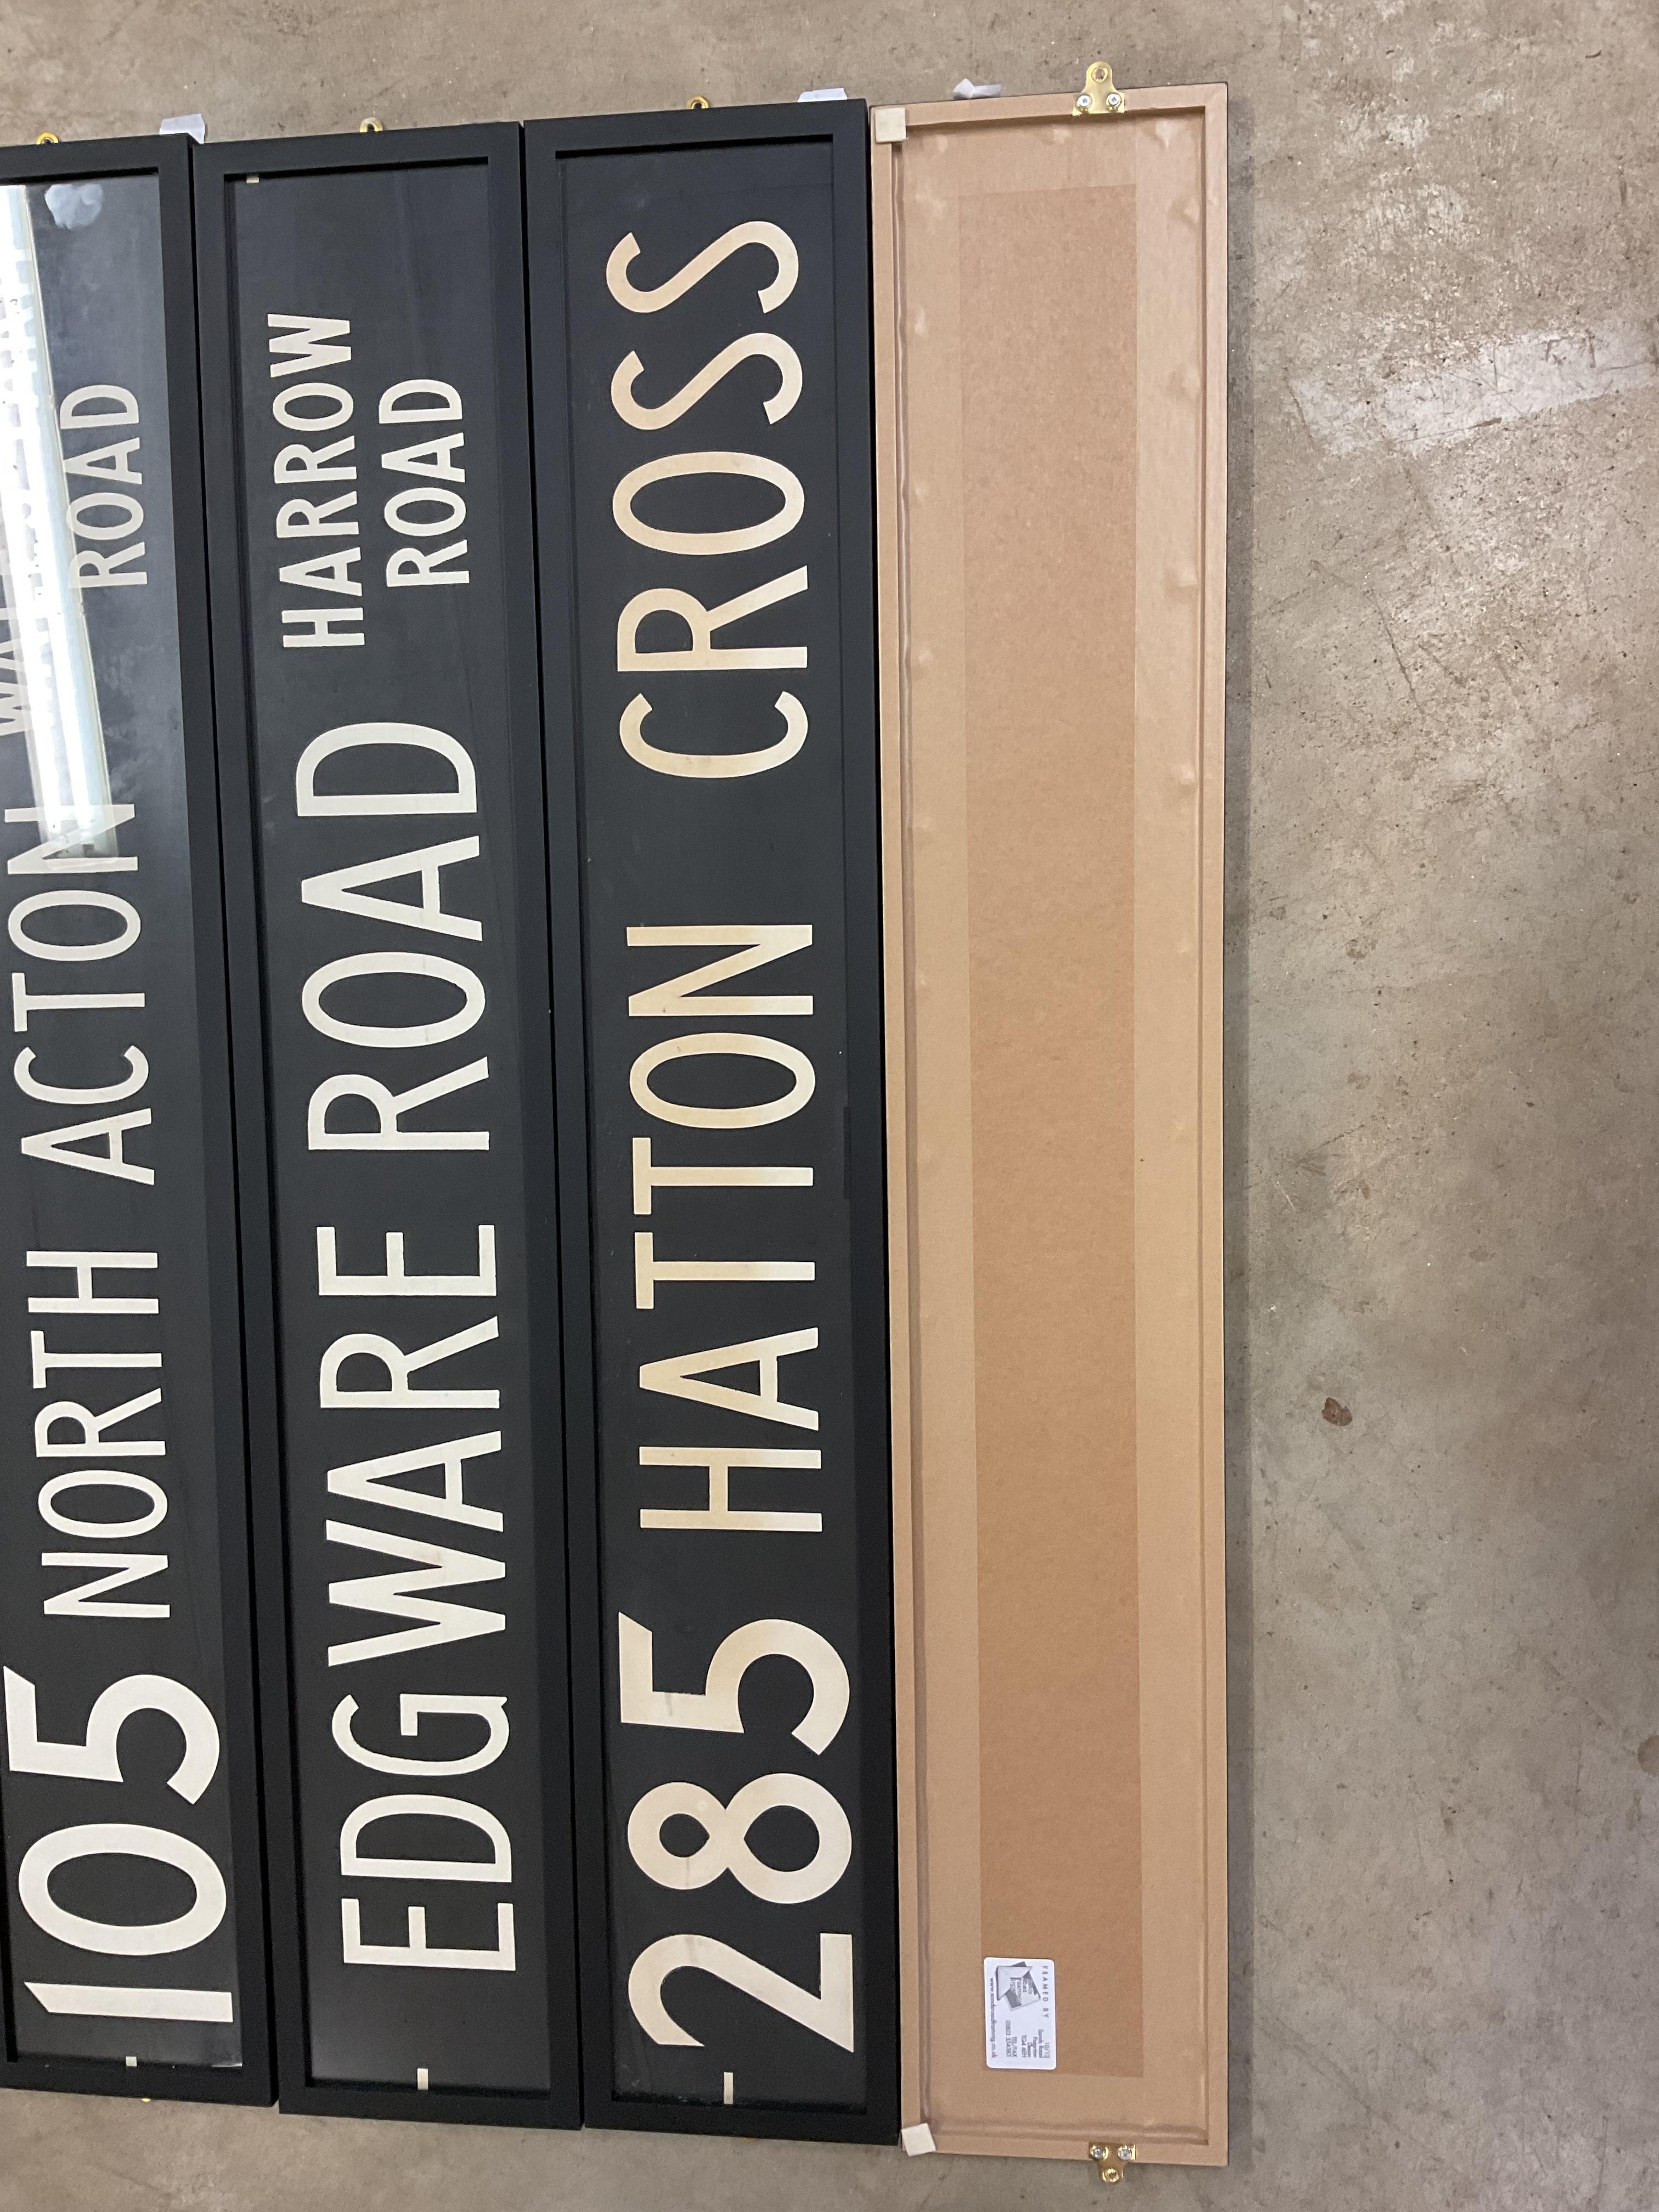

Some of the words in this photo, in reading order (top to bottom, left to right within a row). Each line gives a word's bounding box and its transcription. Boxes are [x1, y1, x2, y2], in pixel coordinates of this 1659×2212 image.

[60, 385, 148, 589] ROAD
[268, 314, 365, 651] HARROW
[379, 379, 470, 588] ROAD
[606, 221, 808, 778] CROSS
[4, 803, 154, 1185] ACTON
[296, 723, 489, 1150] ROAD
[627, 925, 822, 1532] HATTON
[26, 1251, 170, 1618] NORTH
[317, 1225, 516, 1971] EDGWARE
[3, 1666, 233, 2022] 105
[619, 1612, 854, 2052] 285
[1043, 2007, 1049, 2019] BY
